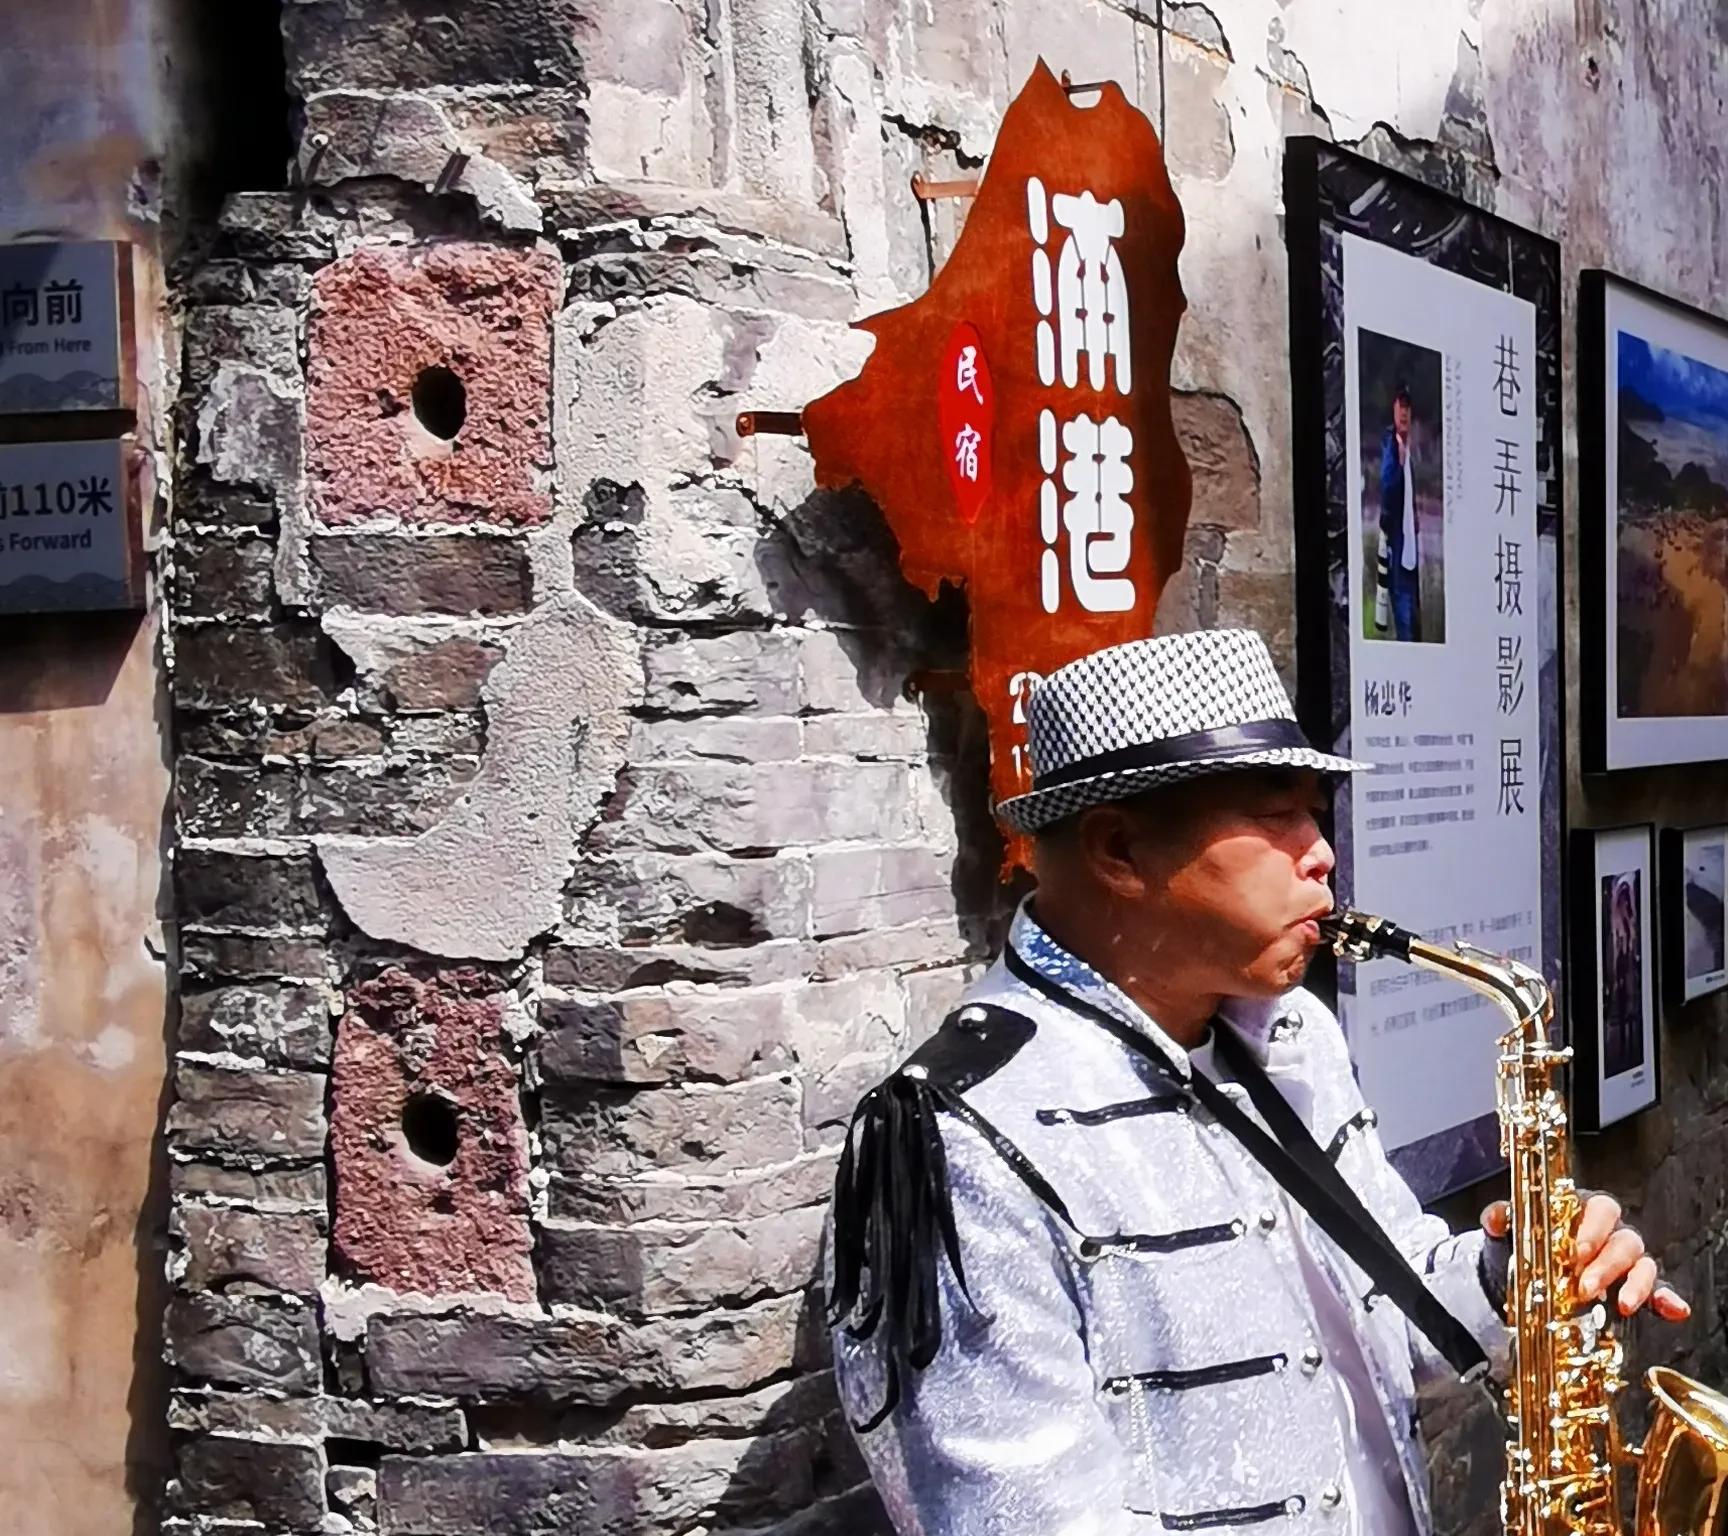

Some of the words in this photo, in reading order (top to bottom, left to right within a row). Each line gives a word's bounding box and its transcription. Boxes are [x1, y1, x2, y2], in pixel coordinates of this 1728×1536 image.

[2, 278, 83, 326] 向前
[53, 336, 92, 353] Here
[955, 345, 984, 483] 民宿
[9, 528, 92, 552] Forward
[1493, 333, 1525, 816] 巷弄摄影展
